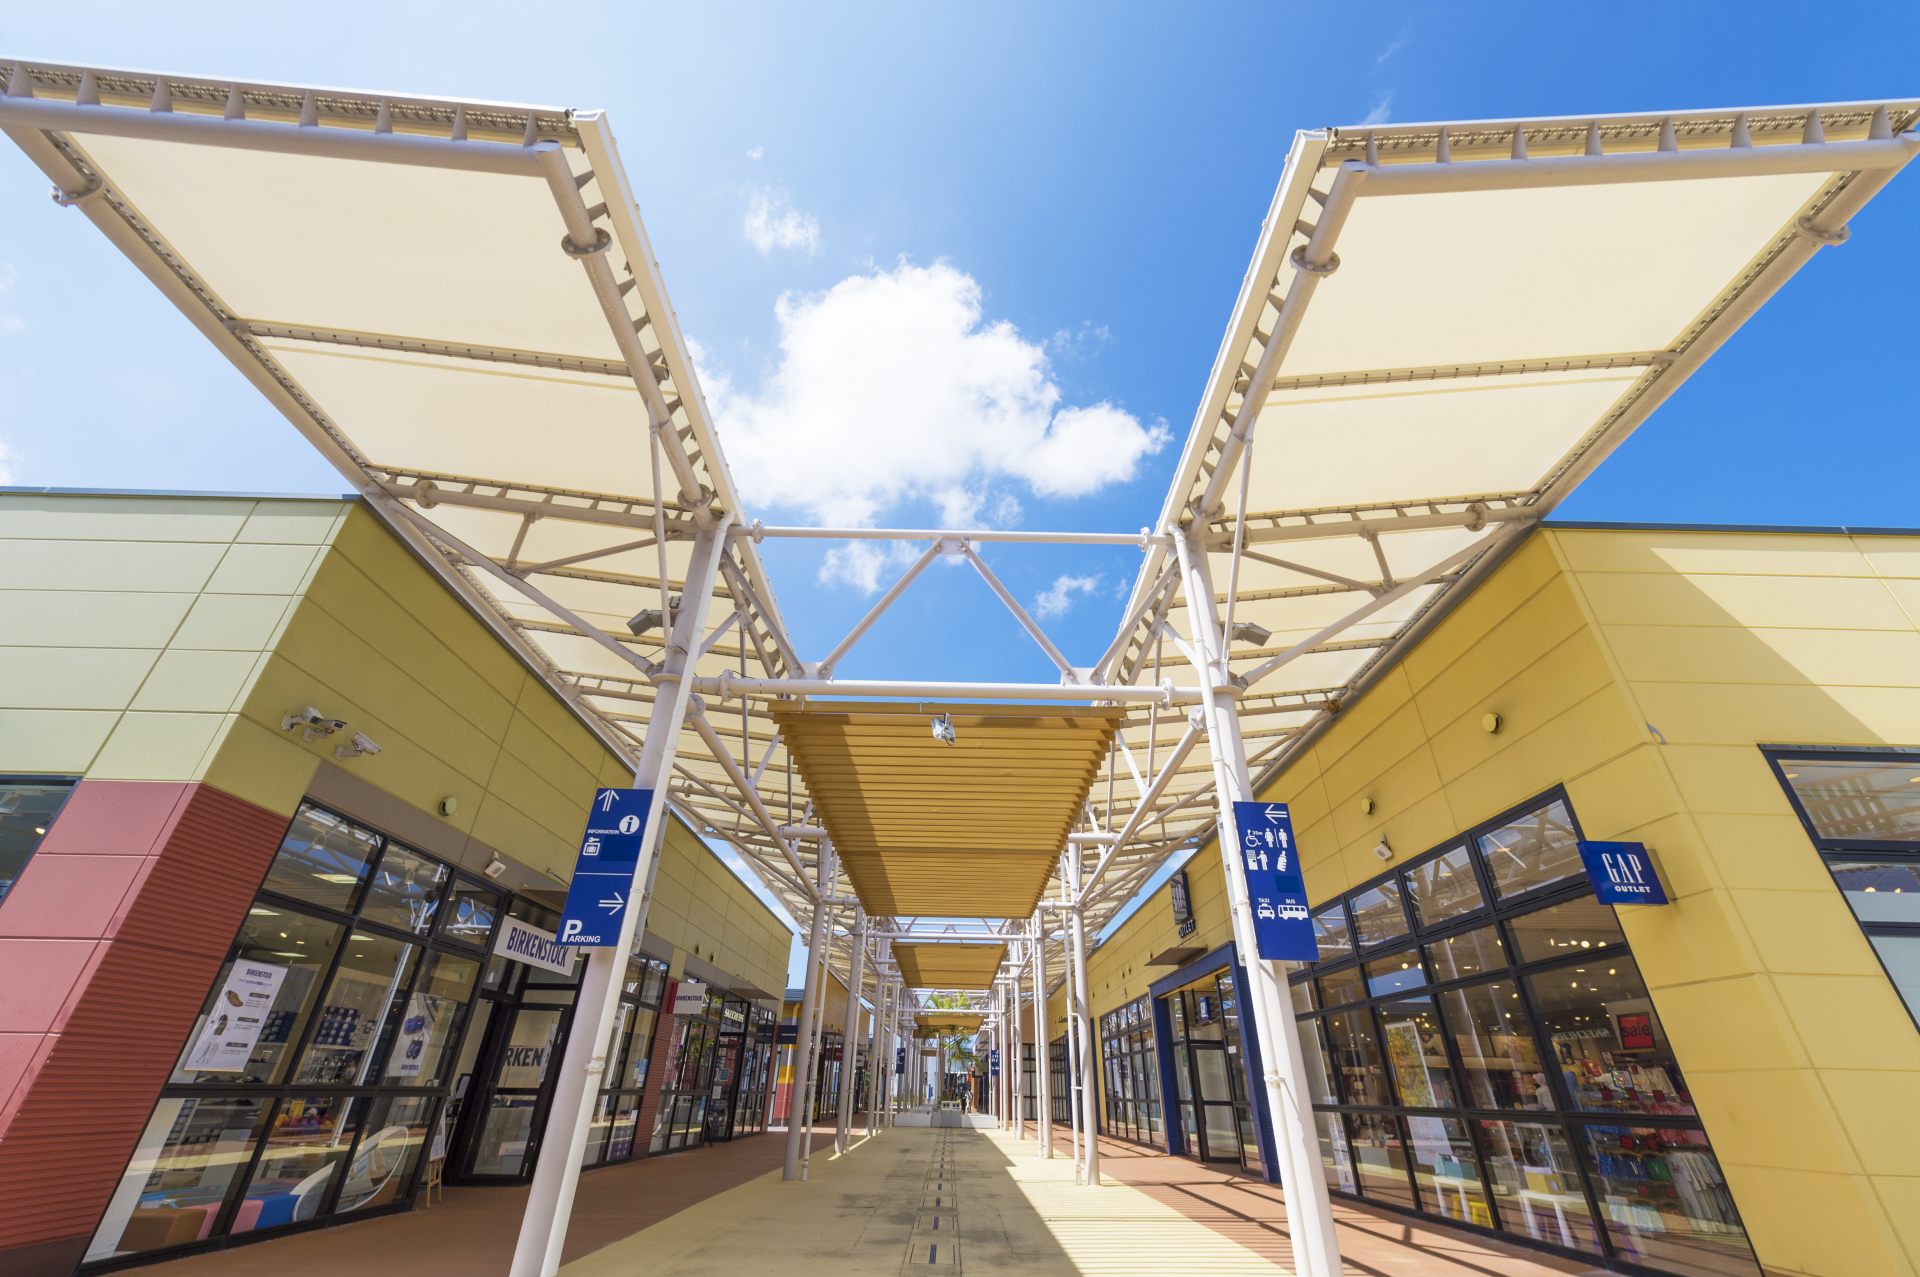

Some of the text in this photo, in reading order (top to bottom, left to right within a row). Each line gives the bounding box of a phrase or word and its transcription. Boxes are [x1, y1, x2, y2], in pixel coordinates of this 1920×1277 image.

[1601, 853, 1645, 883] GAP
[1614, 885, 1651, 893] OUTLET
[561, 919, 601, 943] PARKING
[506, 926, 569, 968] BIRKENSTOCK
[1622, 1021, 1650, 1037] sale
